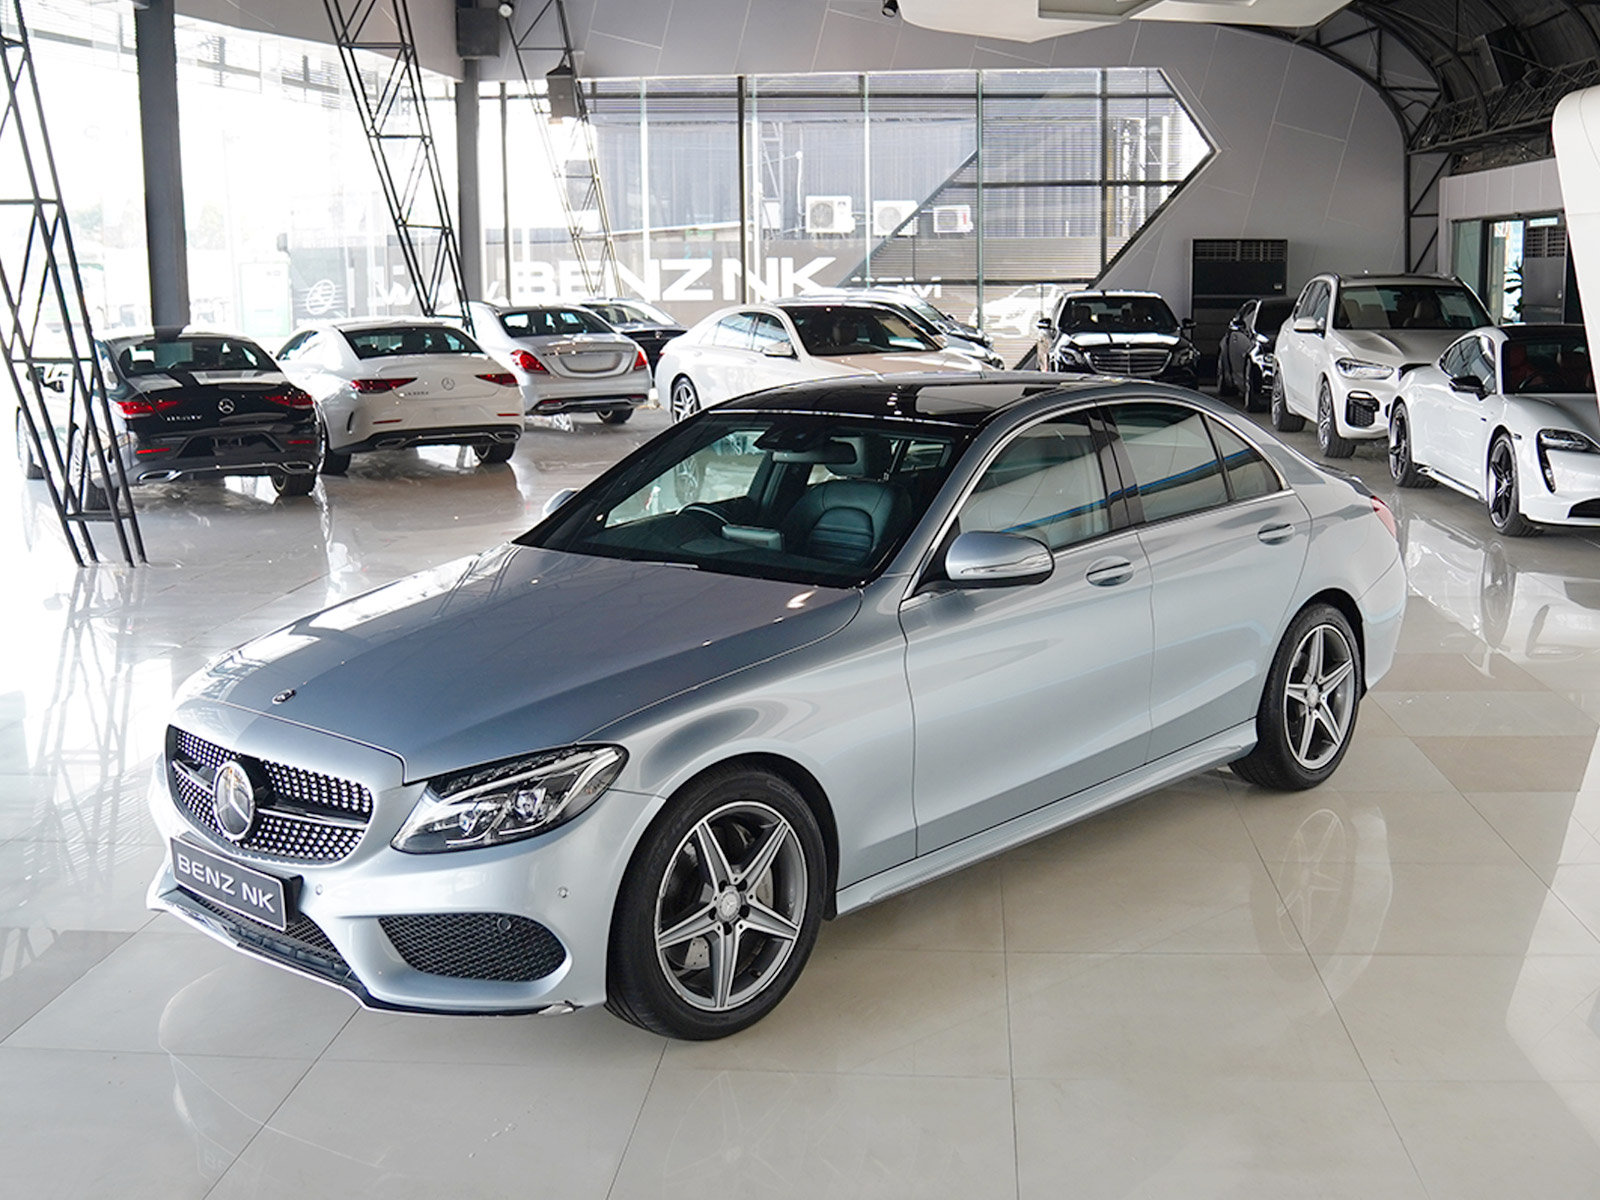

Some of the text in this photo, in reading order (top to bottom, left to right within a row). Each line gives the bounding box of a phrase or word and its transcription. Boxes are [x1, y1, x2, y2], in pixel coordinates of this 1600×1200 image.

[511, 258, 714, 303] BENZ
[721, 256, 837, 302] NK
[177, 852, 275, 913] BENZ NK
